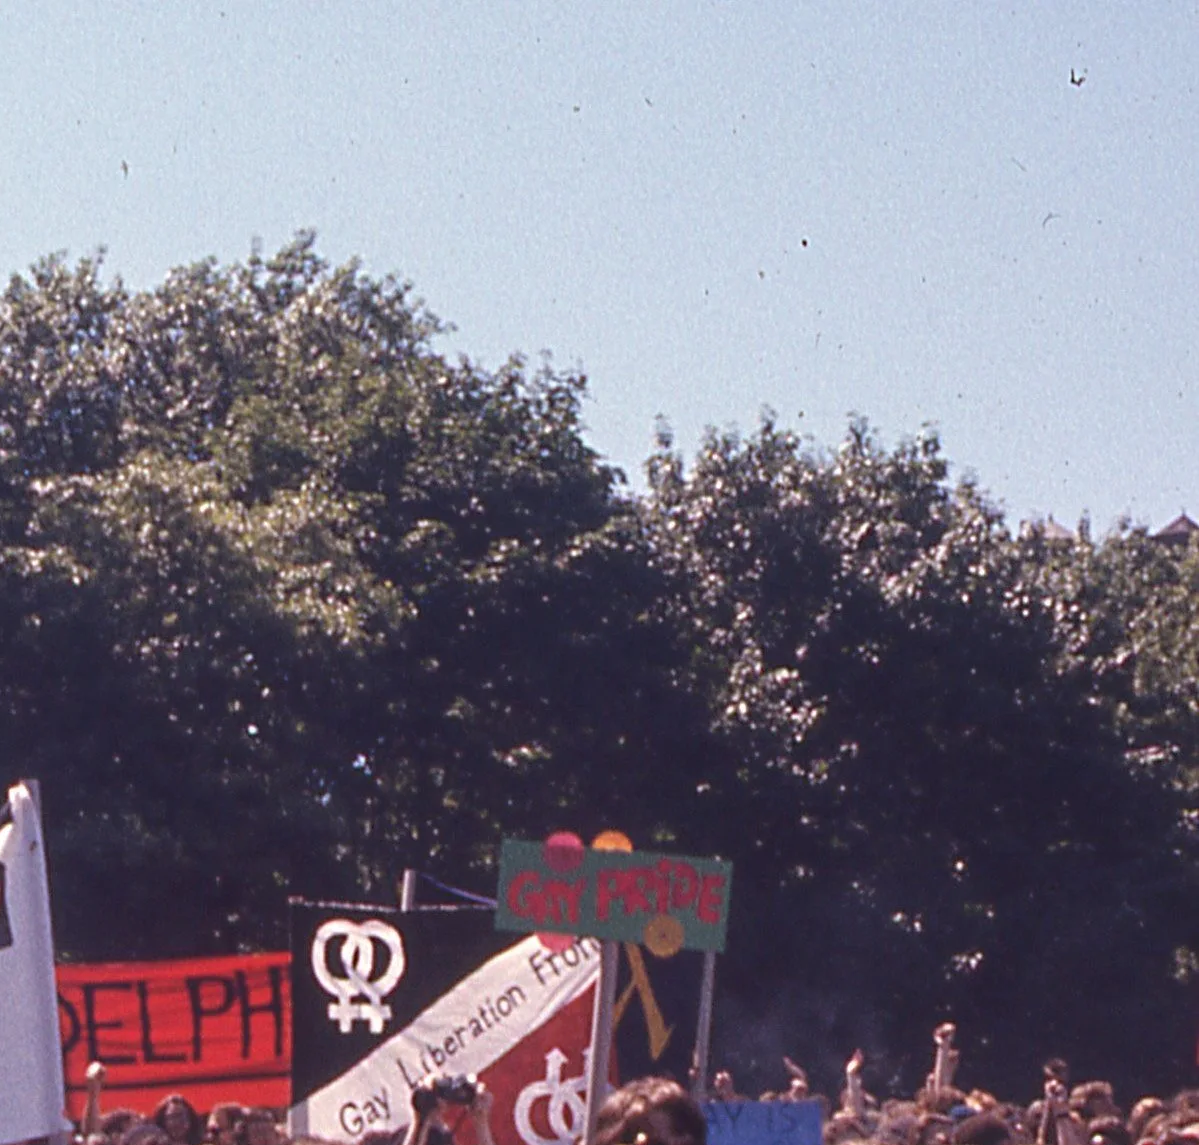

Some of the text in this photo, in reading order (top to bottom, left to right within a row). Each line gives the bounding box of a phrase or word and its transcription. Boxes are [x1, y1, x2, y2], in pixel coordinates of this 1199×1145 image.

[507, 870, 586, 925] GAY
[340, 935, 601, 1136] Gay Liberation Fron
